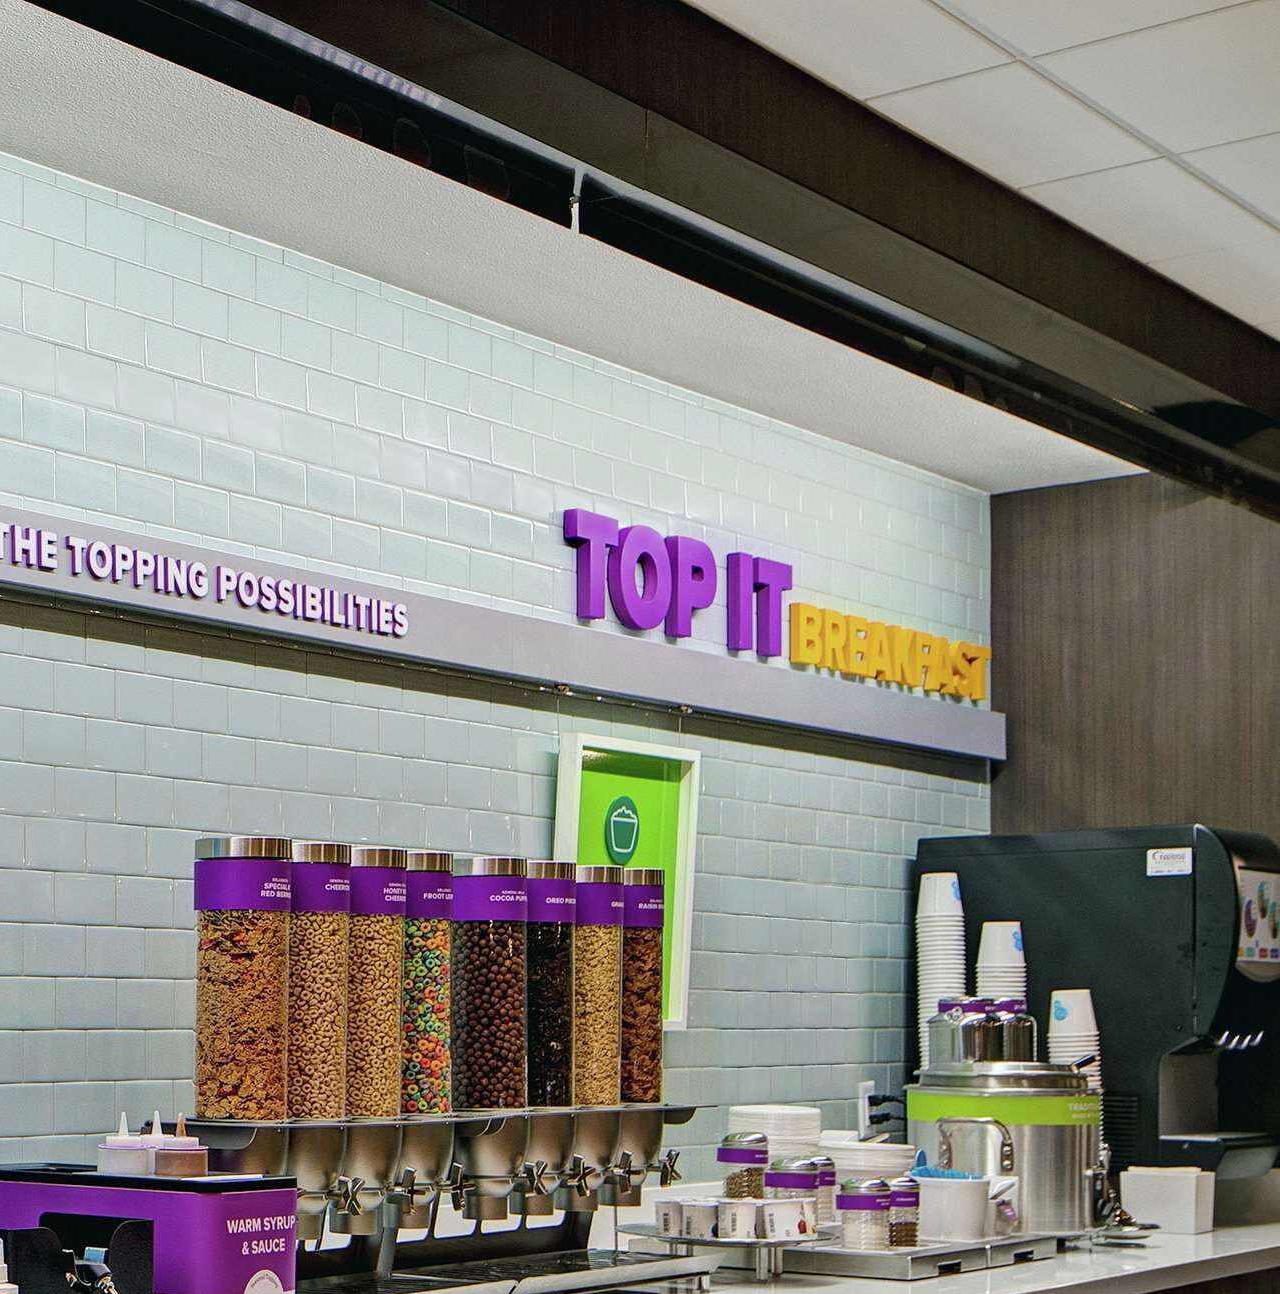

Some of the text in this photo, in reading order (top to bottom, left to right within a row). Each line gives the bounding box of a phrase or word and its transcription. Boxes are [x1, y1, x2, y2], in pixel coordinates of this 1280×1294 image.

[66, 536, 210, 599] TOPPING
[217, 565, 410, 638] POSSIBILITIES
[562, 507, 793, 658] TOP IT
[789, 601, 993, 702] BREAKFAST
[489, 894, 515, 902] COCOA
[546, 897, 564, 905] OREO
[226, 1215, 296, 1234] WARM SYRUP
[242, 1237, 286, 1255] & SAUCE
